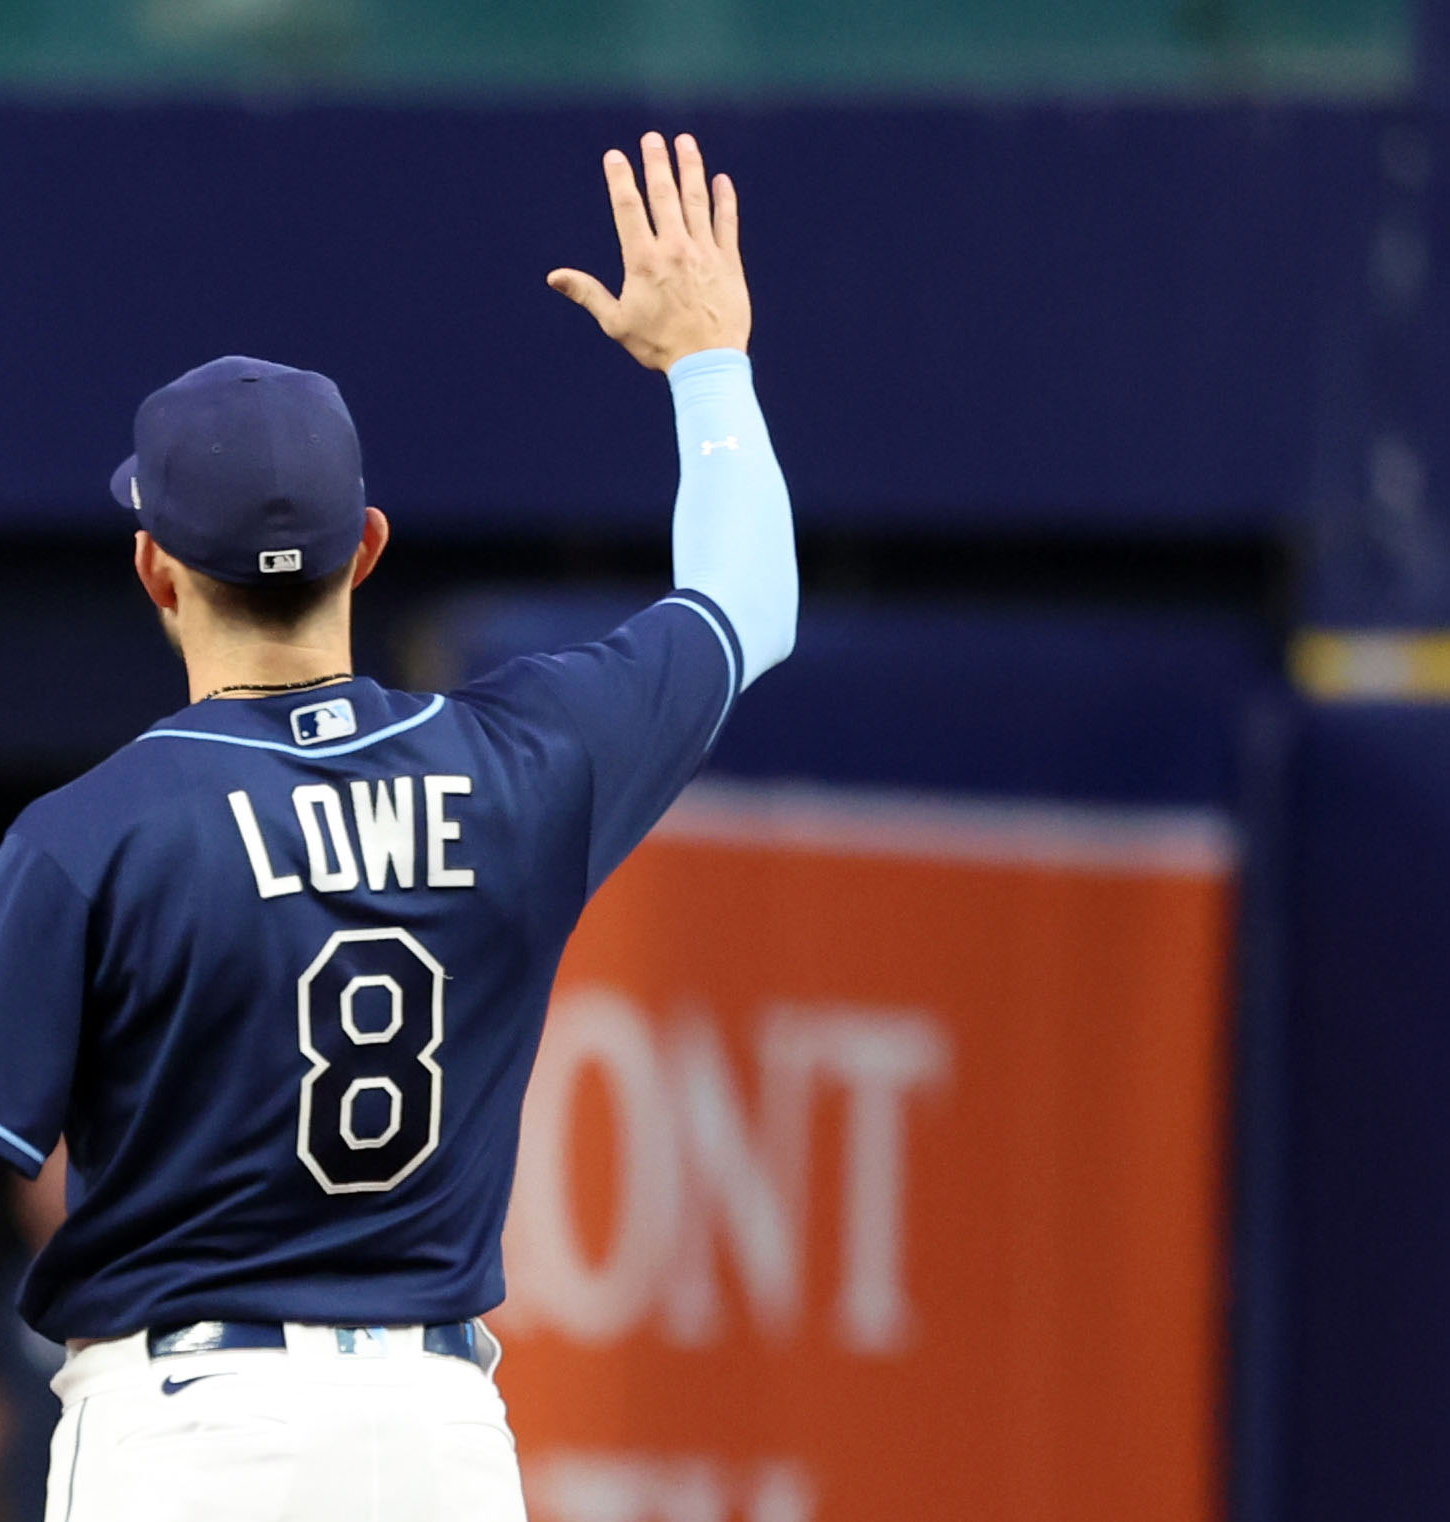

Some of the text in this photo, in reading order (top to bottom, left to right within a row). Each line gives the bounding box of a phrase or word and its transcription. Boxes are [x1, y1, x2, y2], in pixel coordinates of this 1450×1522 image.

[227, 775, 475, 899] LOWE
[298, 927, 445, 1195] 8
[504, 985, 957, 1355] ONT
